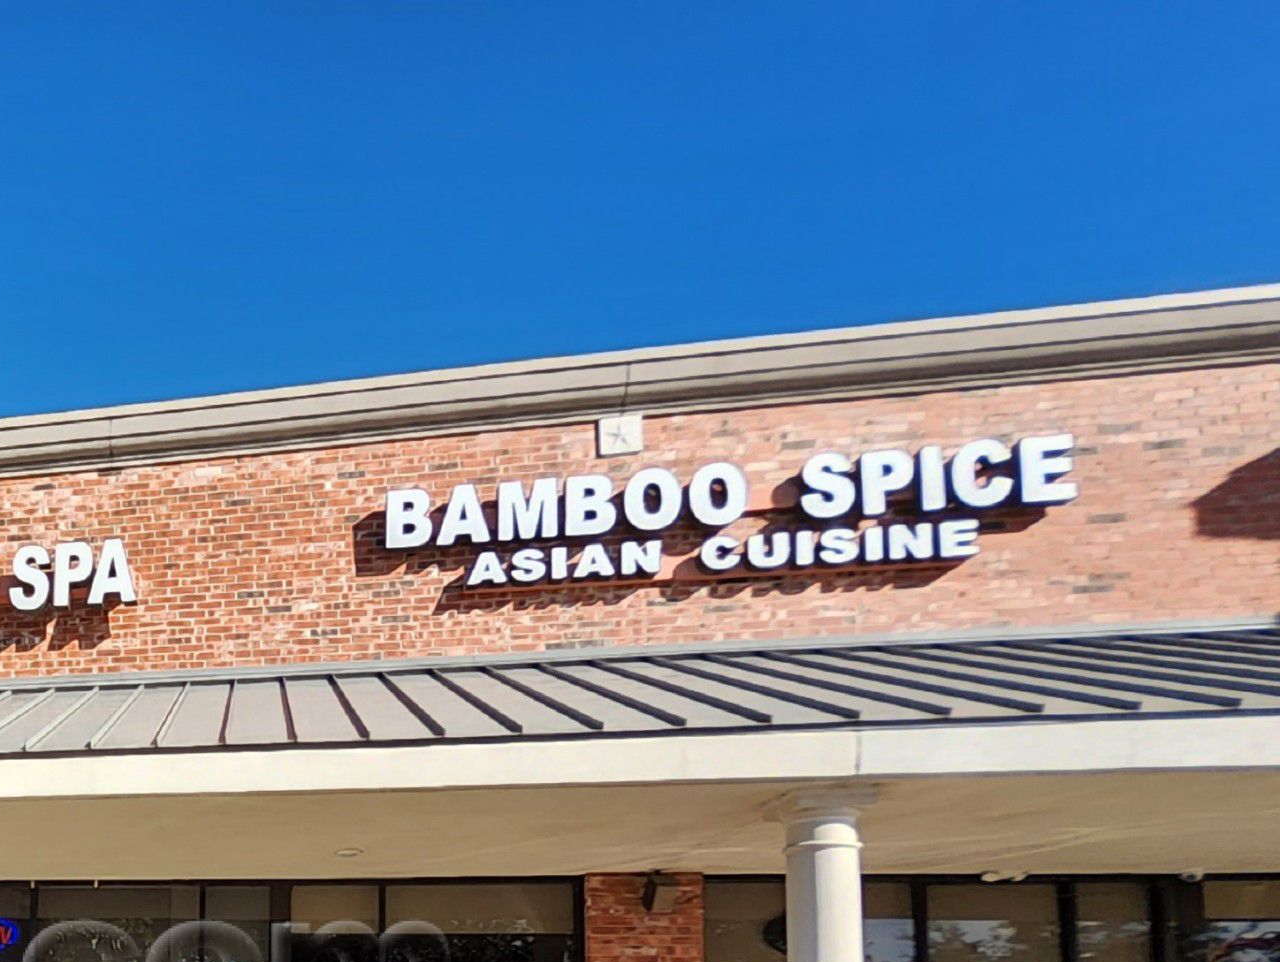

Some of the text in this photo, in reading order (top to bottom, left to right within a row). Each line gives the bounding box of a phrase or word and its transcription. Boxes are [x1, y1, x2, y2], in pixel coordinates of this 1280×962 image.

[385, 433, 1079, 549] BAMBOO SPICE
[8, 539, 138, 611] SPA
[466, 519, 981, 586] ASIAN CUISINE
